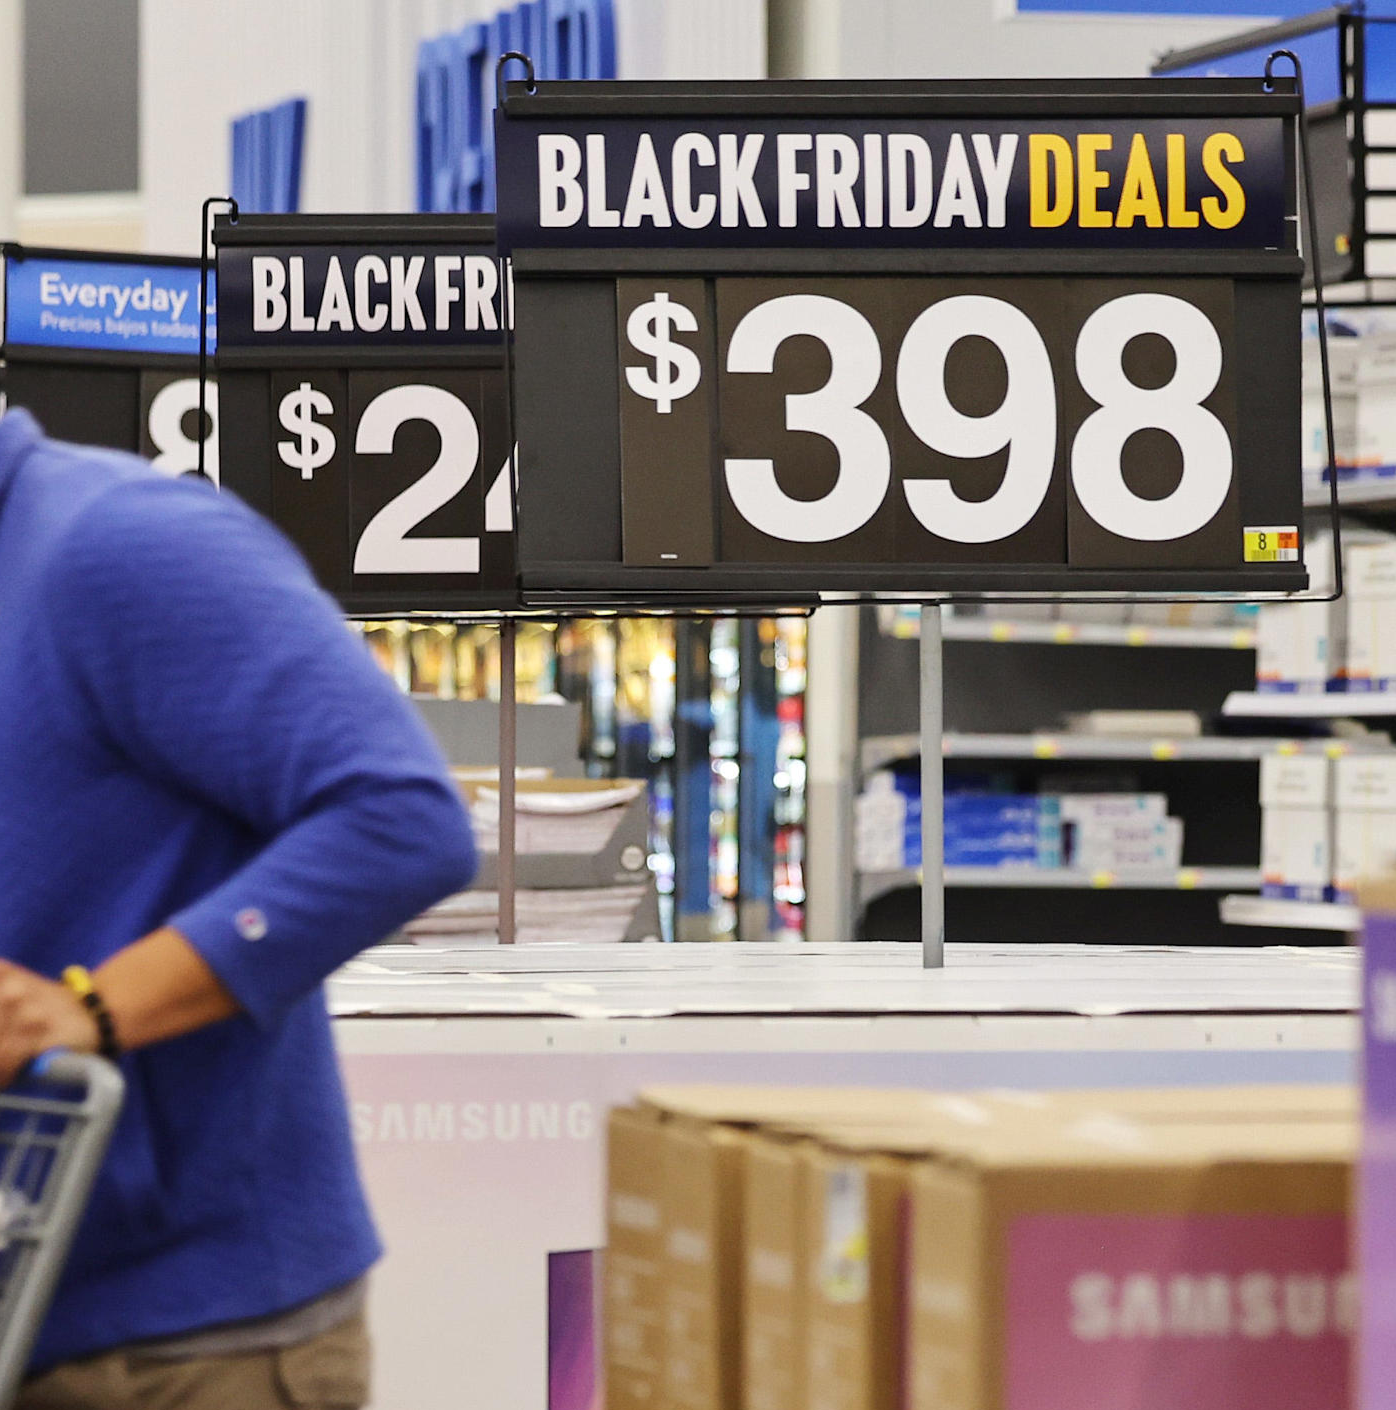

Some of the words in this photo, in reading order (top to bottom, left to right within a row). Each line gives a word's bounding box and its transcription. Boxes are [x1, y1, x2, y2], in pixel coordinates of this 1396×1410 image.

[537, 132, 765, 229] BLACK
[777, 132, 1020, 229] FRIDAY
[1028, 132, 1247, 230] DEALS
[39, 271, 190, 322] Everyday
[40, 311, 103, 334] Precios
[252, 255, 428, 333] BLACK
[625, 292, 1234, 544] $398
[1258, 532, 1267, 550] 8
